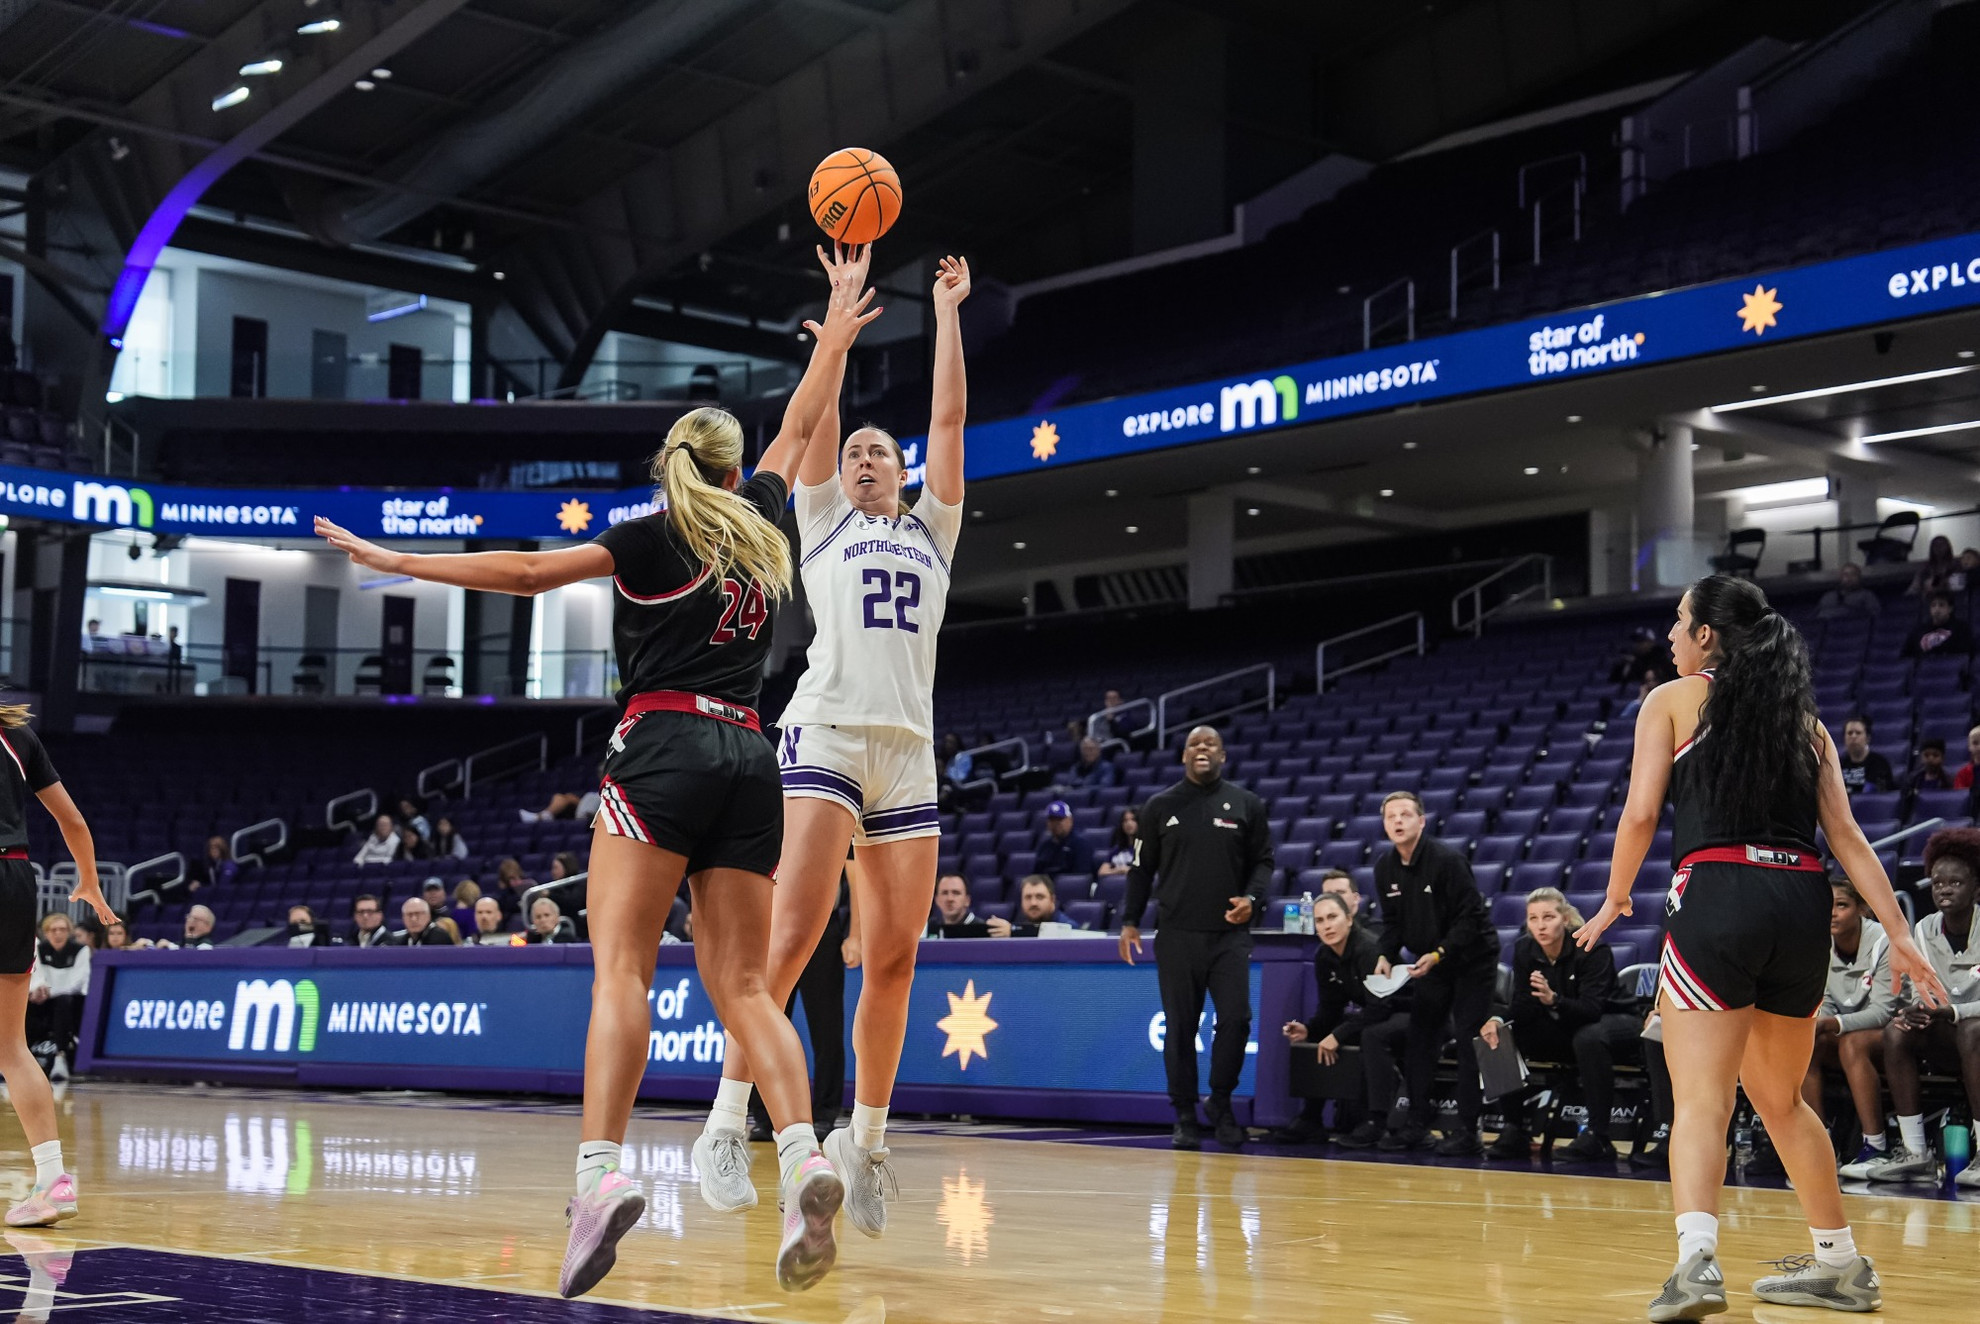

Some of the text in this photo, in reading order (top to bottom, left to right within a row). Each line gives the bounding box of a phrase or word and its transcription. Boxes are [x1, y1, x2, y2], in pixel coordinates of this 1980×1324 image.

[1529, 314, 1604, 352] star of
[1528, 333, 1638, 376] the north
[381, 514, 477, 534] the north
[382, 496, 449, 517] star of
[709, 577, 768, 645] 24
[862, 568, 921, 634] 22
[657, 978, 690, 1019] of
[647, 1021, 725, 1062] north
